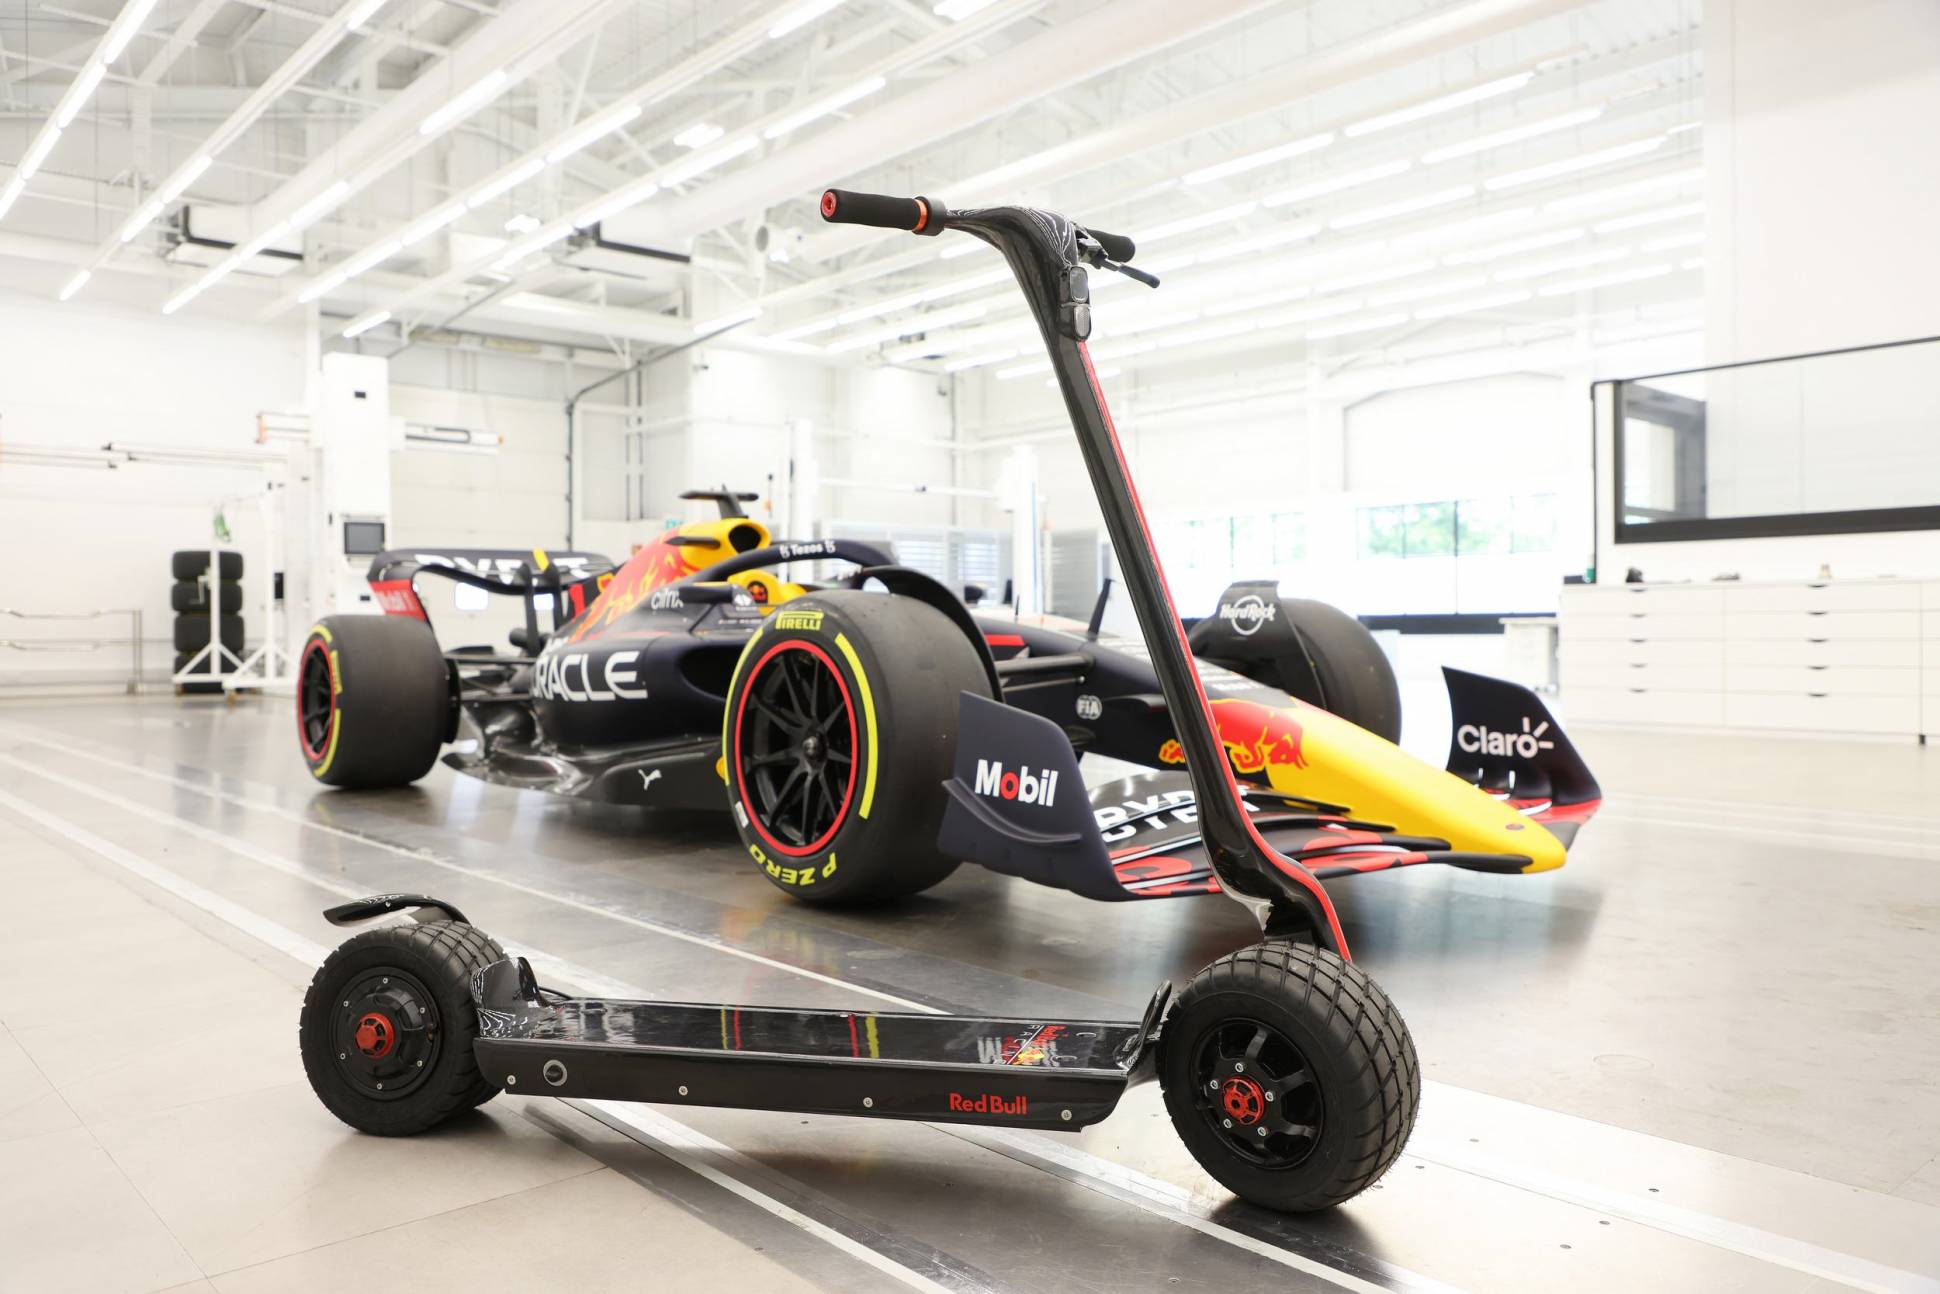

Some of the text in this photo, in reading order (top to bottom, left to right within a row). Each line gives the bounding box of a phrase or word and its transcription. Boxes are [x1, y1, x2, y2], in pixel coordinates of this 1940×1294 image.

[775, 610, 824, 631] PIRELLI
[1457, 724, 1539, 759] Claro
[975, 759, 1058, 807] Mobil
[749, 844, 815, 886] ZERO
[950, 1092, 1028, 1115] Red Bull
